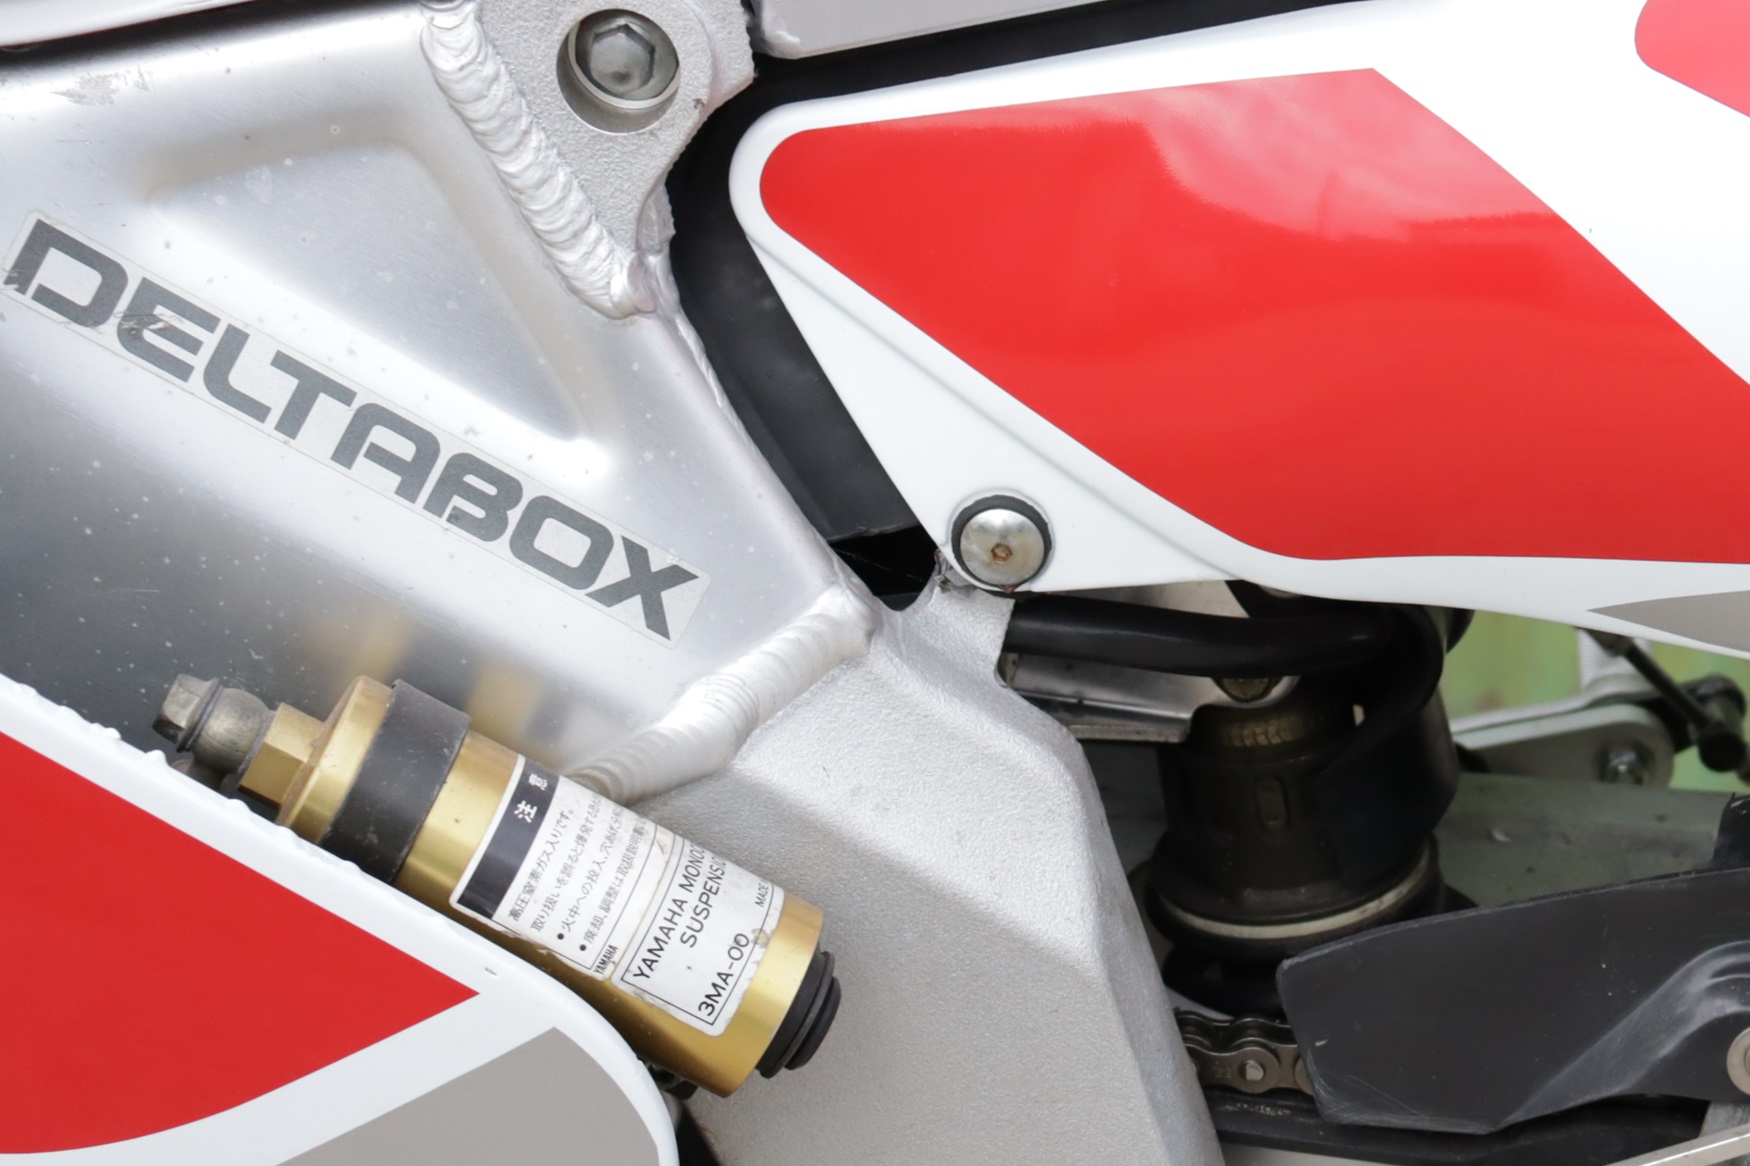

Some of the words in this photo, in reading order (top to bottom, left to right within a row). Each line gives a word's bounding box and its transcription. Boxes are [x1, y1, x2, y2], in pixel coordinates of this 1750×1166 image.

[3, 219, 699, 640] DELTABOX
[754, 883, 769, 907] MADE
[594, 944, 619, 975] YAMAHA
[633, 898, 689, 980] YAMAHA
[698, 933, 749, 1017] 3MA-00
